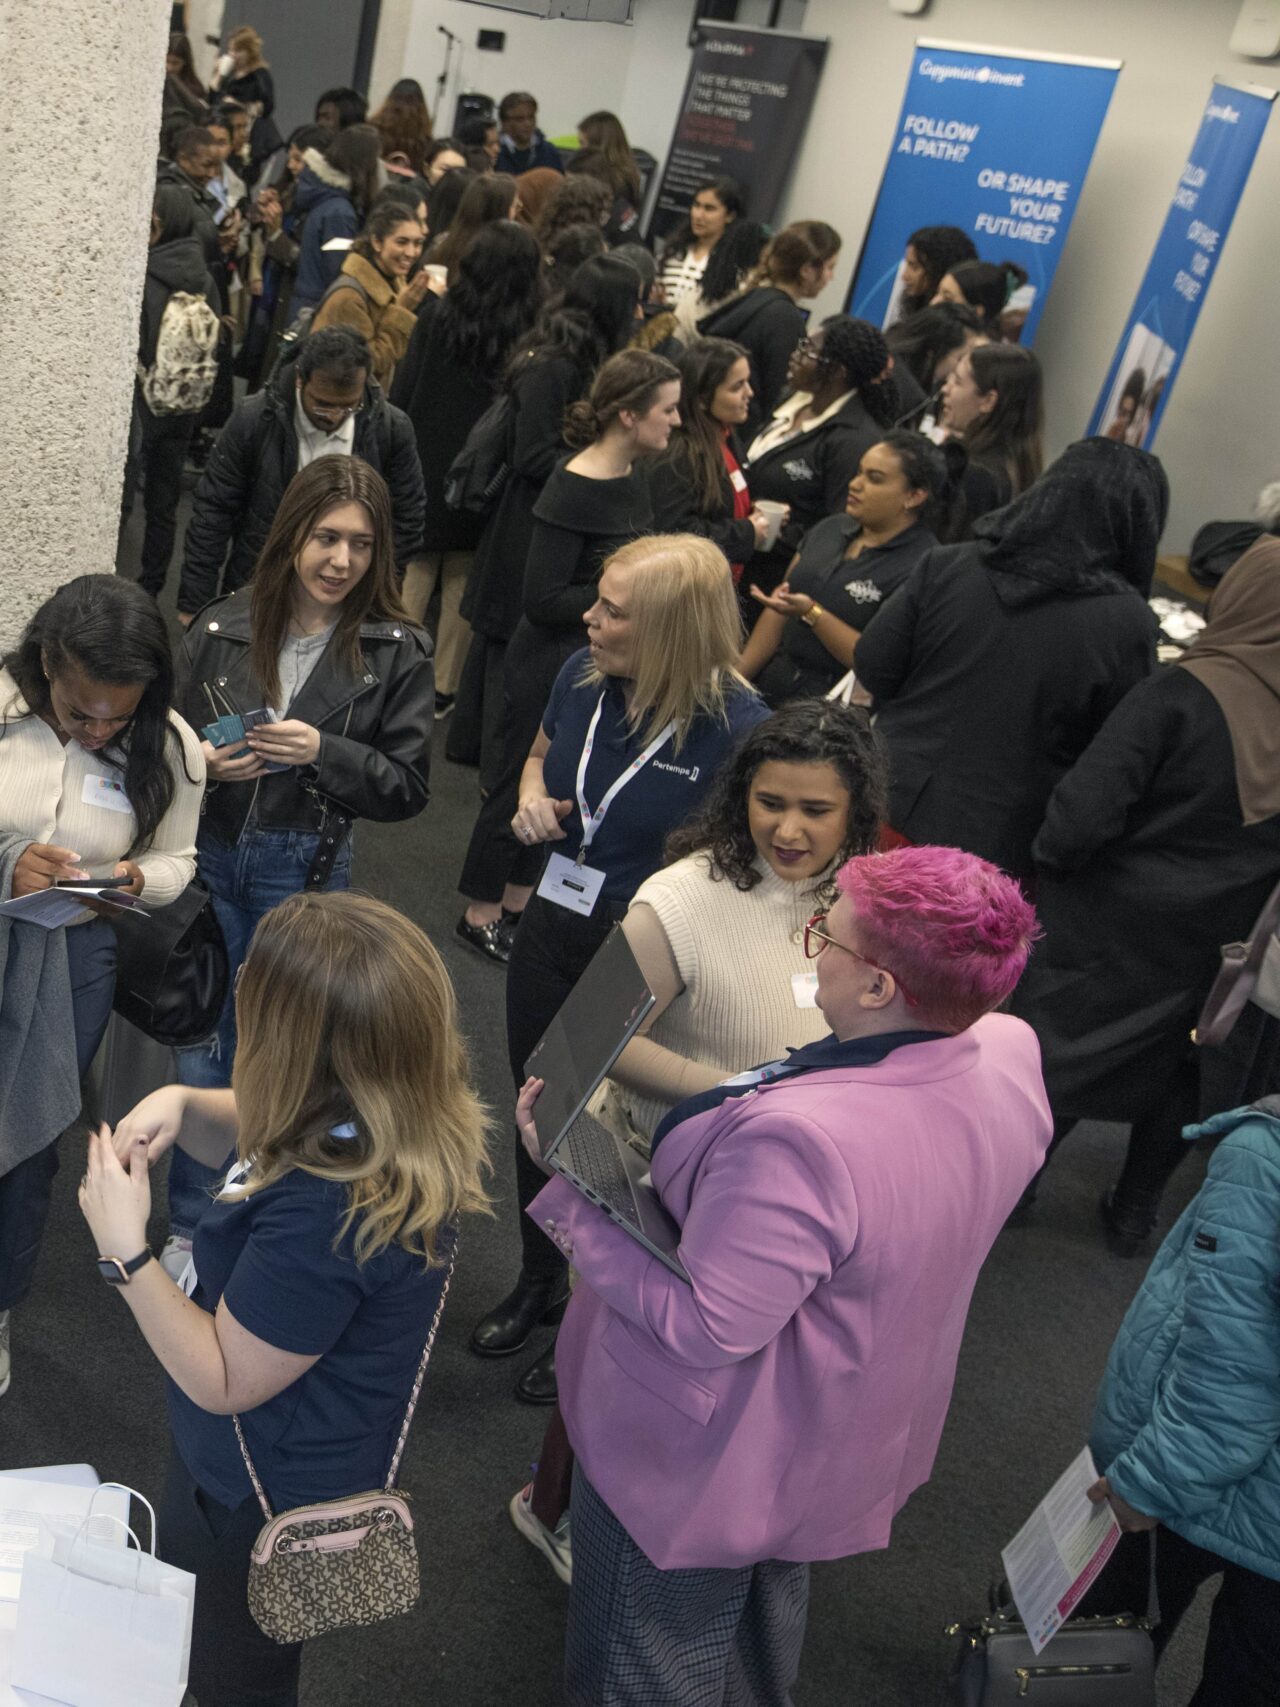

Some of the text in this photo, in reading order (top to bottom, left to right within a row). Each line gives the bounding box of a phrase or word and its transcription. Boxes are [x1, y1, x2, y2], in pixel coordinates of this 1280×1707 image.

[694, 87, 752, 107] THE THINGS
[729, 76, 789, 98] PROTECTING
[714, 104, 753, 122] MATTER
[903, 114, 980, 143] FOLLOW
[897, 135, 971, 163] A PATH?
[976, 168, 1070, 201] OR SHAPE
[1009, 196, 1062, 223] YOUR
[974, 212, 1057, 245] FUTURE?
[652, 759, 690, 776] Pertemps
